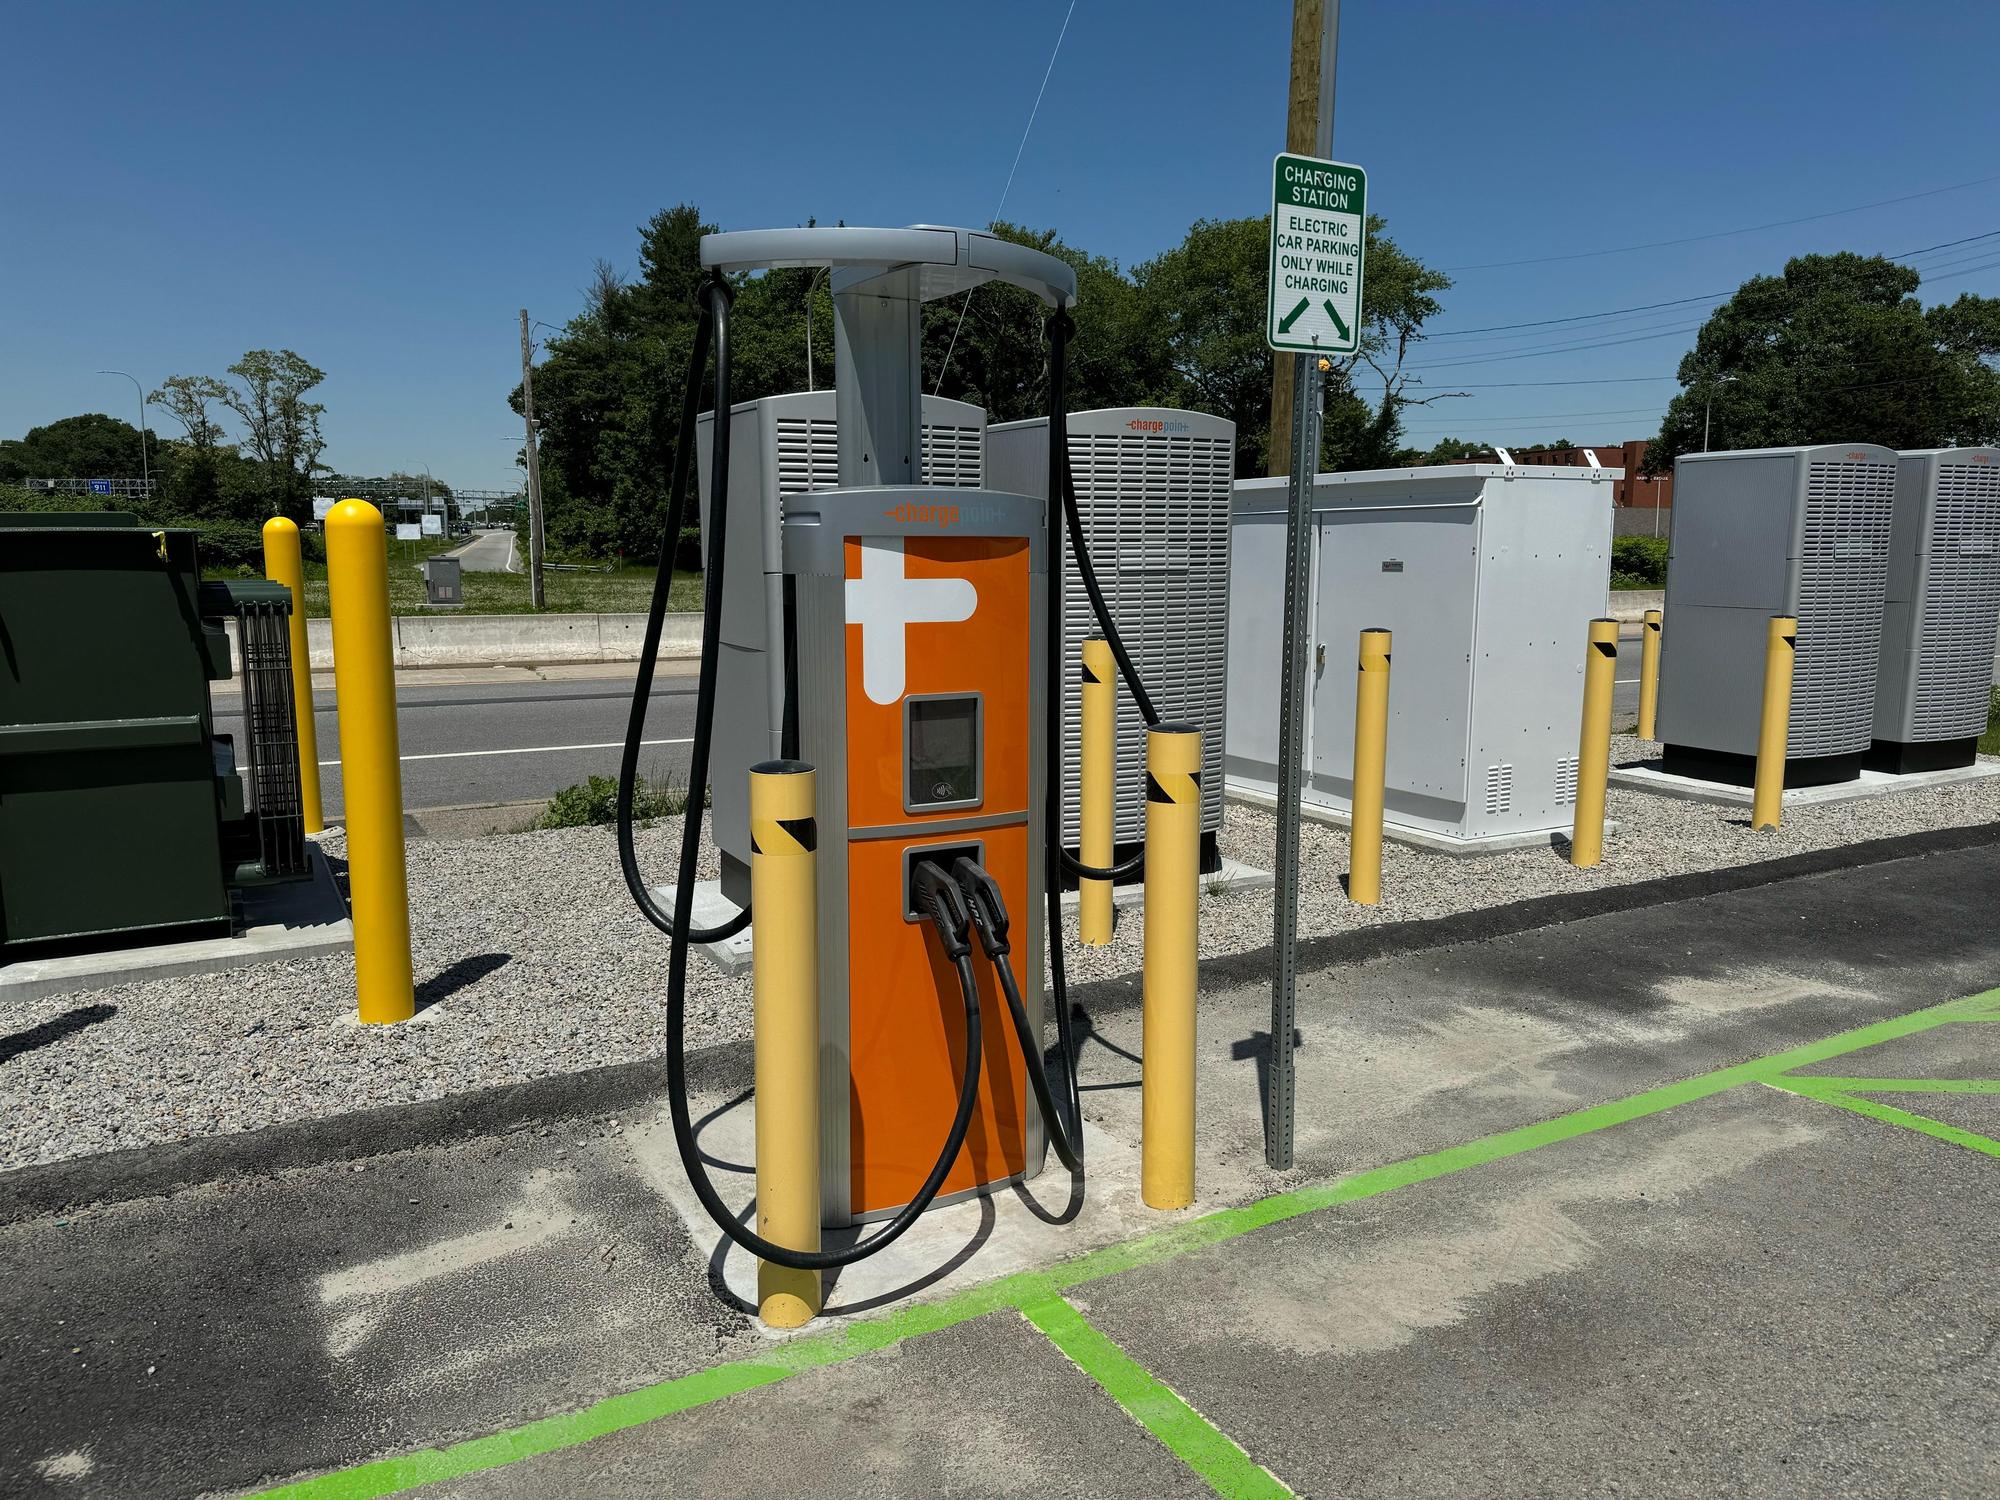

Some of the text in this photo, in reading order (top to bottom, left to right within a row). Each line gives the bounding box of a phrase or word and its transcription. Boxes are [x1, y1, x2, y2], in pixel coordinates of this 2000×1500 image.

[1285, 165, 1357, 192] CHARGING
[1292, 186, 1348, 209] STATION
[1290, 216, 1348, 237] ELECTRIC
[1277, 233, 1359, 257] CAR PARKING
[1281, 255, 1353, 276] ONLY WHILE
[1285, 274, 1348, 294] CHARGING
[967, 898, 983, 926] HPC
